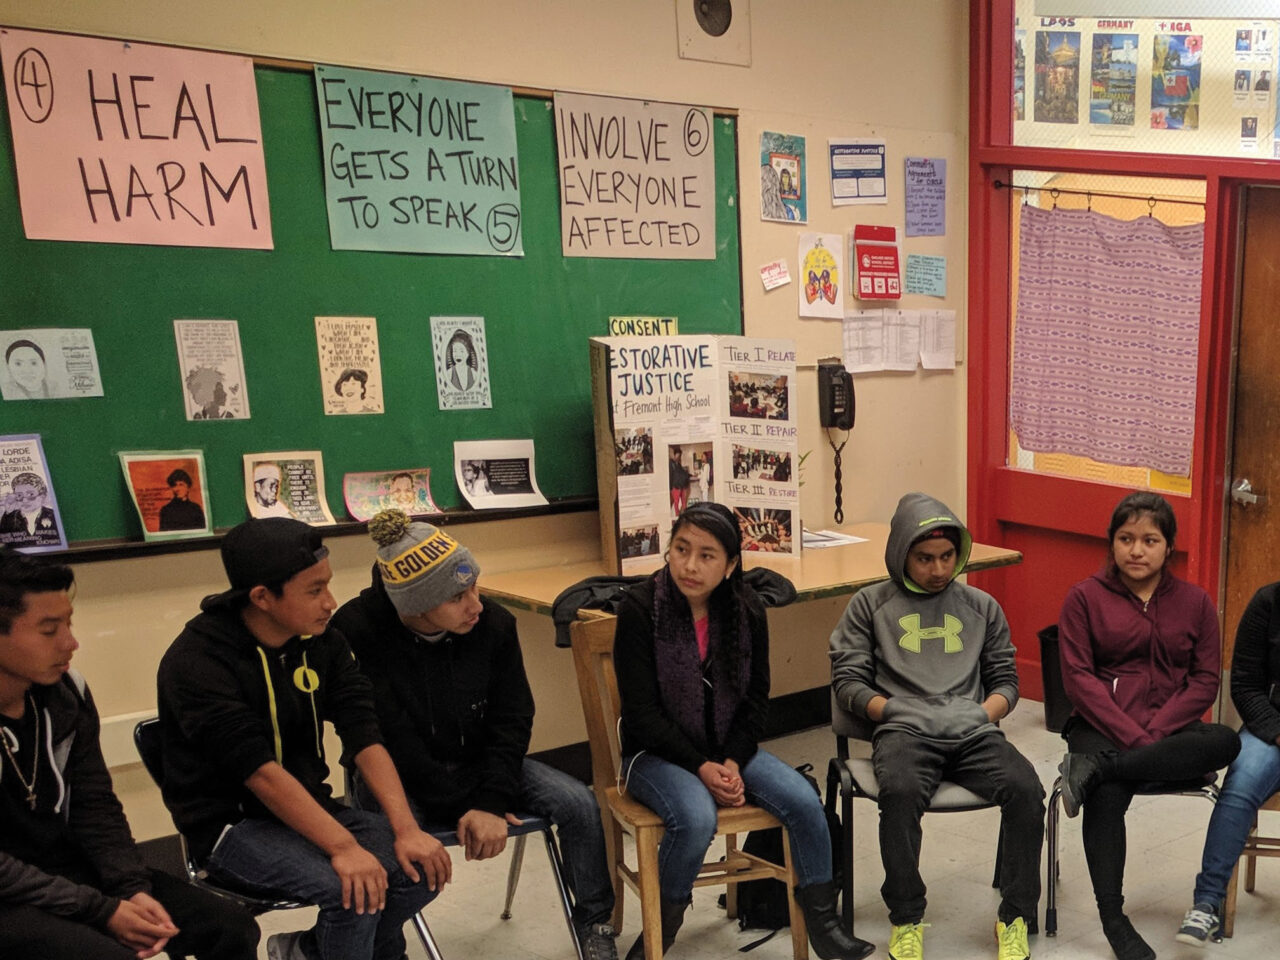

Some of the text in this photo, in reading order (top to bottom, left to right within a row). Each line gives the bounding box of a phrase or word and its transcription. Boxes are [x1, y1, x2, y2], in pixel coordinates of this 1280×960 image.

[1097, 20, 1134, 29] GERMANY
[87, 69, 258, 152] HEAL
[321, 78, 485, 142] EVERYONE
[560, 108, 671, 165] INVOLVE
[330, 142, 518, 191] GETS A TURN
[77, 157, 258, 230] HARM
[563, 165, 702, 213] EVERYONE
[337, 195, 379, 229] TO
[389, 195, 483, 234] SPEAK
[568, 216, 701, 250] AFFECTED
[611, 318, 673, 336] CONSENT
[610, 344, 713, 370] ESTORATIVE
[723, 345, 796, 362] TIER I RELATE
[618, 371, 695, 397] JUSTICE
[624, 397, 662, 418] Fremont
[665, 394, 682, 417] High
[686, 393, 711, 410] School
[721, 422, 748, 434] TIER
[751, 424, 763, 436] II
[766, 424, 797, 437] REPAIR
[3, 447, 31, 456] LORDE
[724, 480, 750, 494] TIER
[752, 485, 765, 495] III
[394, 535, 453, 578] GOLDEN
